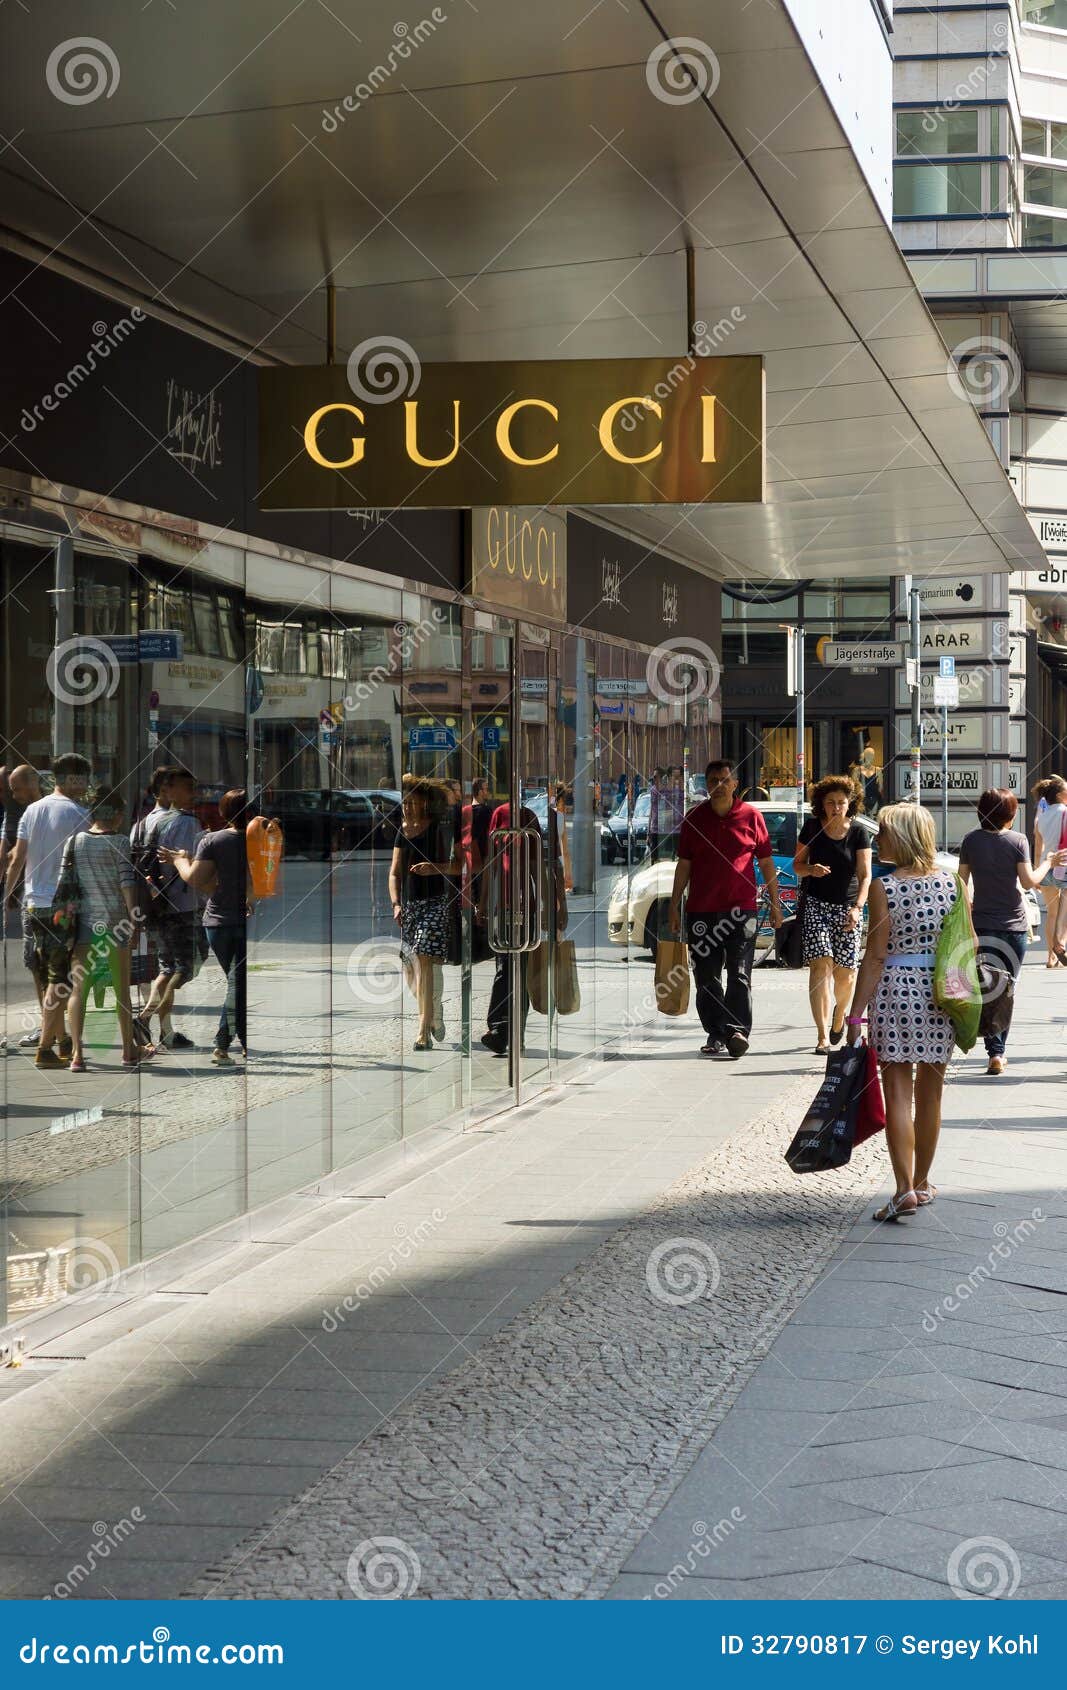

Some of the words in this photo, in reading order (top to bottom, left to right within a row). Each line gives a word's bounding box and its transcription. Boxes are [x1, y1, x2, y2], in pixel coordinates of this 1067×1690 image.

[304, 395, 717, 469] GUCCI
[487, 507, 557, 589] GUCCI
[919, 584, 954, 602] ginarium
[922, 633, 970, 648] ARAR
[834, 646, 896, 661] Jägerstraße
